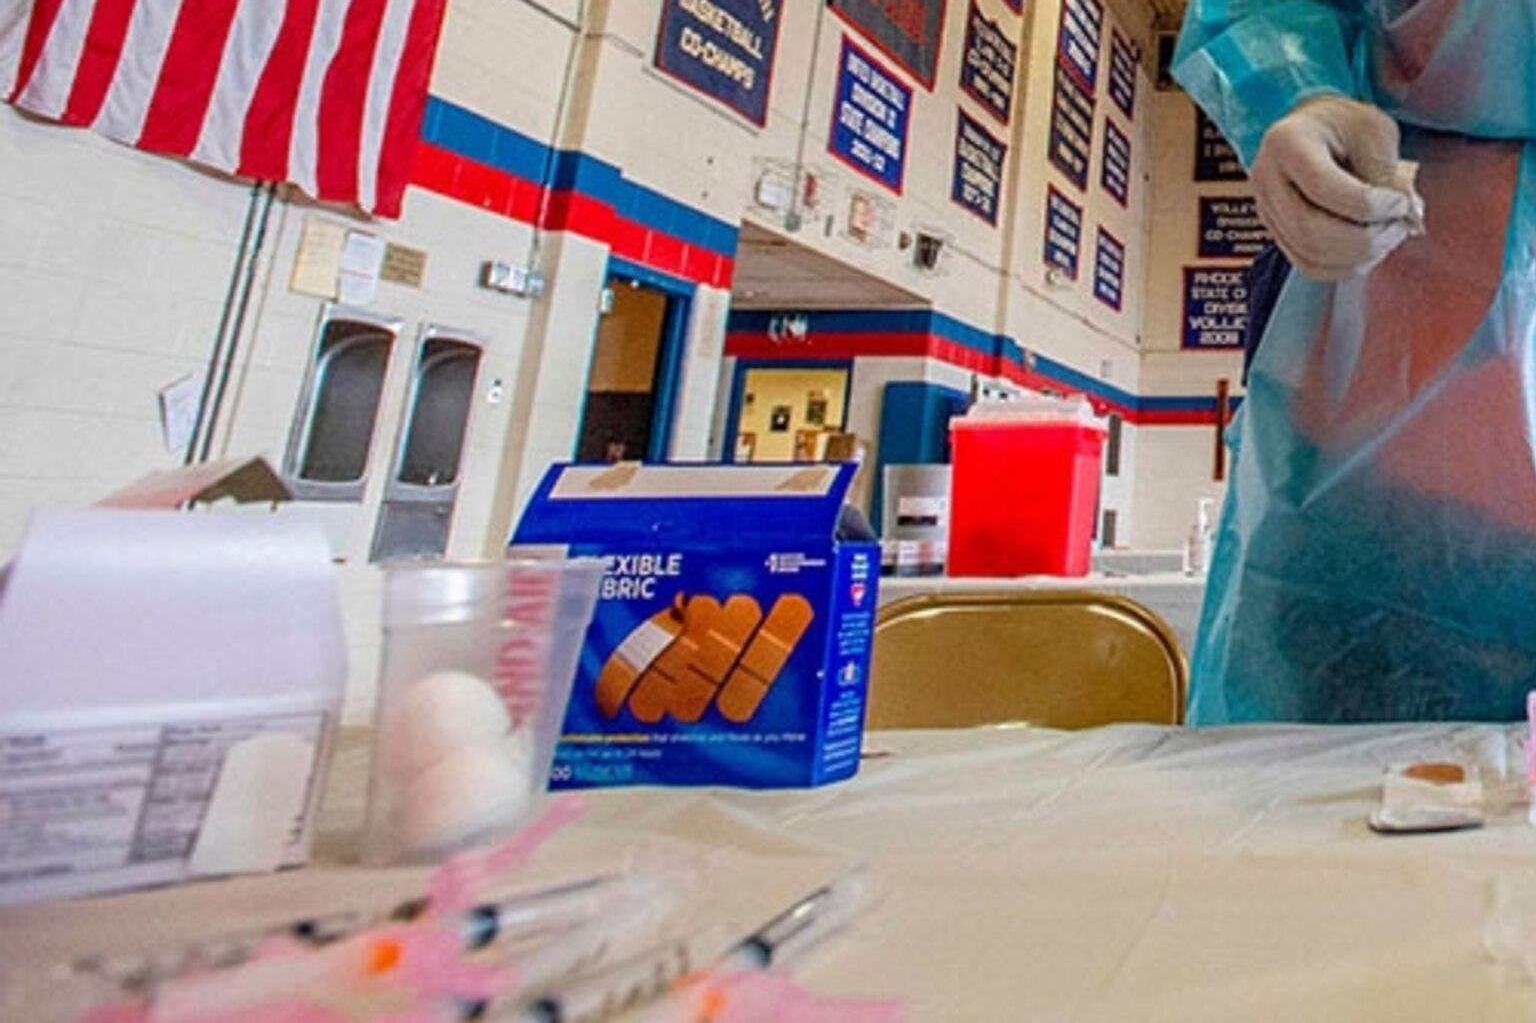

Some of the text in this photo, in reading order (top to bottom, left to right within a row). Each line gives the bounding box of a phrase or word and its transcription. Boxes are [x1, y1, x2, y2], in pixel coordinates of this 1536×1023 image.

[679, 27, 755, 89] CO-CHAMPS
[604, 552, 683, 576] EXIBLE
[601, 576, 657, 599] BRIC
